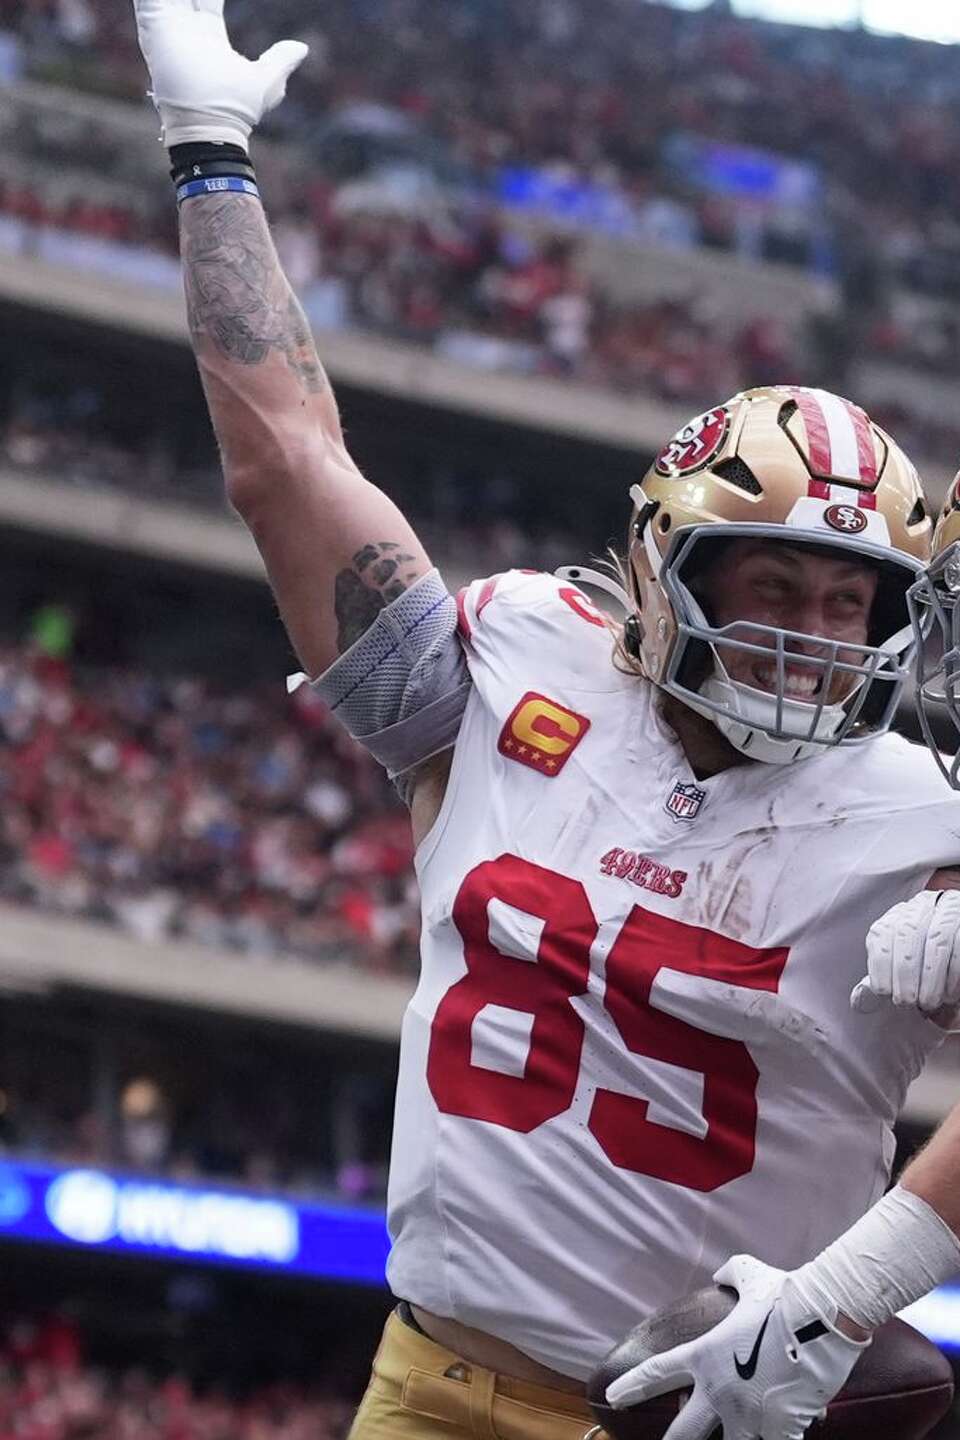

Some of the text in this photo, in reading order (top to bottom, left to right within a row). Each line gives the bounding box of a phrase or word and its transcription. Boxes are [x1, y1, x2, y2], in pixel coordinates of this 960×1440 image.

[511, 699, 581, 756] C
[599, 846, 688, 899] 49ERS
[426, 852, 791, 1193] 85
